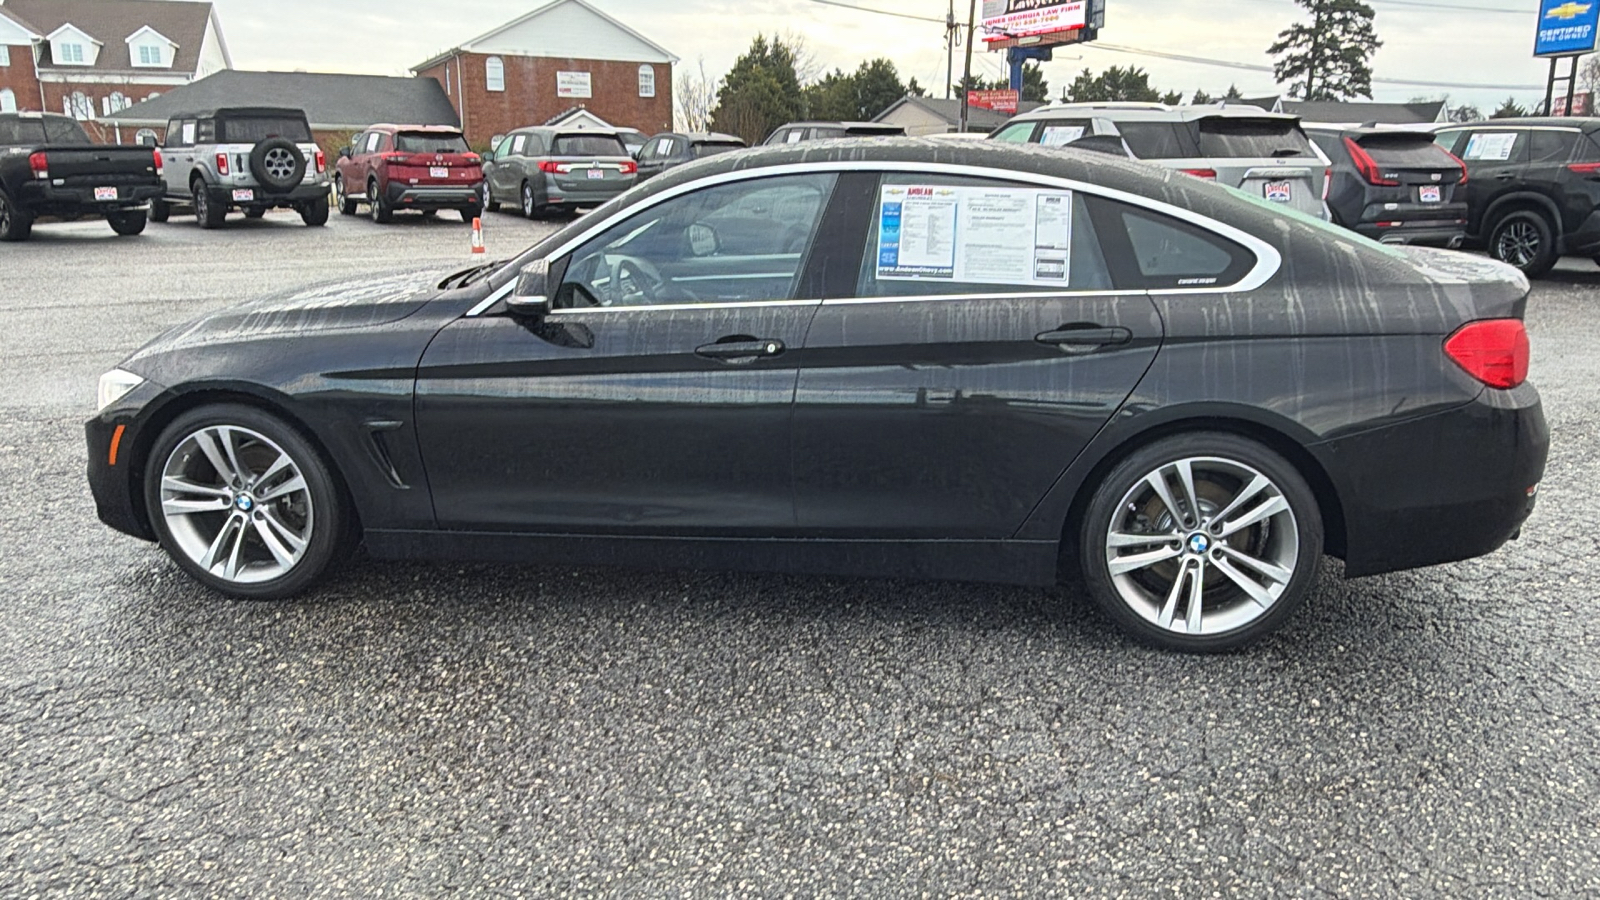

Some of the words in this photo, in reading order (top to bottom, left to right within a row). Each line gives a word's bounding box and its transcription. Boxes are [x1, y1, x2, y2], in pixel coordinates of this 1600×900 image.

[1007, 12, 1040, 22] GEORGIA
[1042, 8, 1059, 16] LAW
[1060, 4, 1081, 13] FIRM
[1540, 25, 1591, 37] CERTIFIED
[907, 187, 934, 196] ANDEAN
